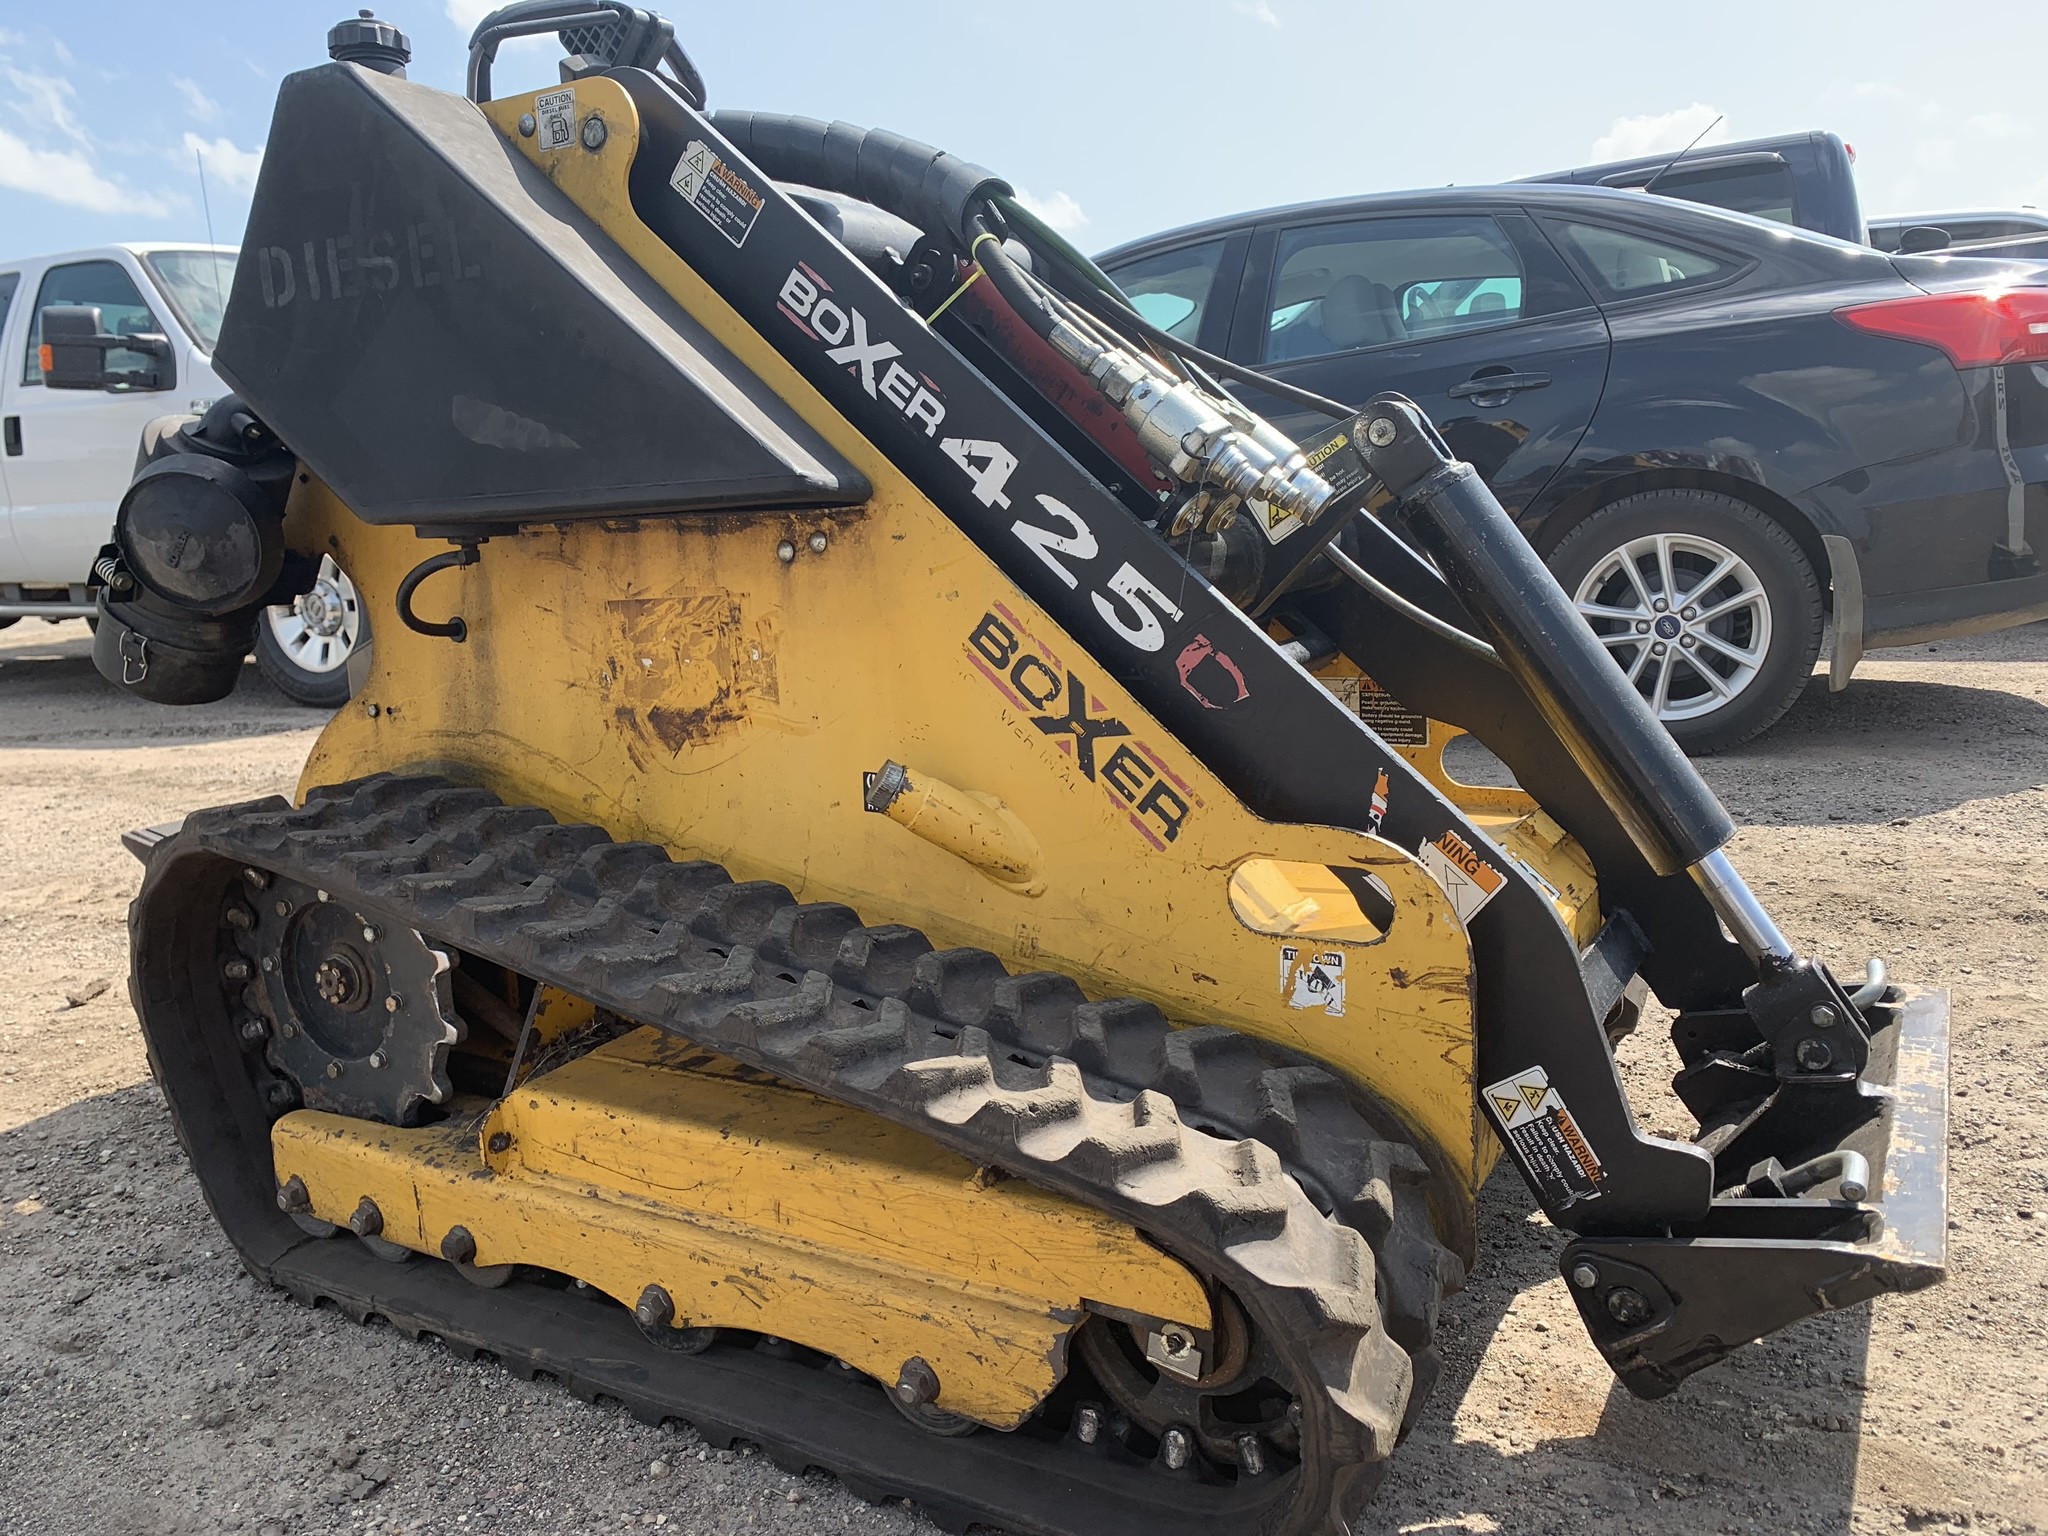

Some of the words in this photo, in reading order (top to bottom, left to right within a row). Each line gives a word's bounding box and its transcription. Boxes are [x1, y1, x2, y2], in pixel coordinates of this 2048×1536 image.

[539, 93, 571, 107] CAUTION
[541, 107, 558, 115] DIESEL
[705, 178, 717, 191] Keep
[709, 171, 726, 188] CRUSH
[725, 186, 746, 207] HAZARD!
[721, 168, 758, 206] WARNING
[695, 198, 711, 214] serious
[698, 192, 711, 205] result
[714, 206, 727, 219] death
[701, 186, 715, 200] Failure
[719, 203, 734, 218] comply
[733, 216, 747, 229] could
[258, 221, 483, 309] DIESEL
[778, 267, 947, 438] BOXER
[1308, 440, 1339, 467] UTION
[967, 611, 1191, 844] BOXER
[1436, 833, 1480, 876] NING
[1312, 953, 1339, 965] OWN
[1512, 1129, 1529, 1154] serious
[1519, 1125, 1534, 1146] result
[1531, 1145, 1539, 1153] in
[1535, 1152, 1550, 1172] death
[1527, 1122, 1544, 1146] Failure
[1541, 1145, 1549, 1154] to
[1545, 1153, 1563, 1177] comply
[1535, 1119, 1549, 1137] Keep
[1546, 1136, 1560, 1155] clear.
[1561, 1143, 1586, 1178] HAZARD!
